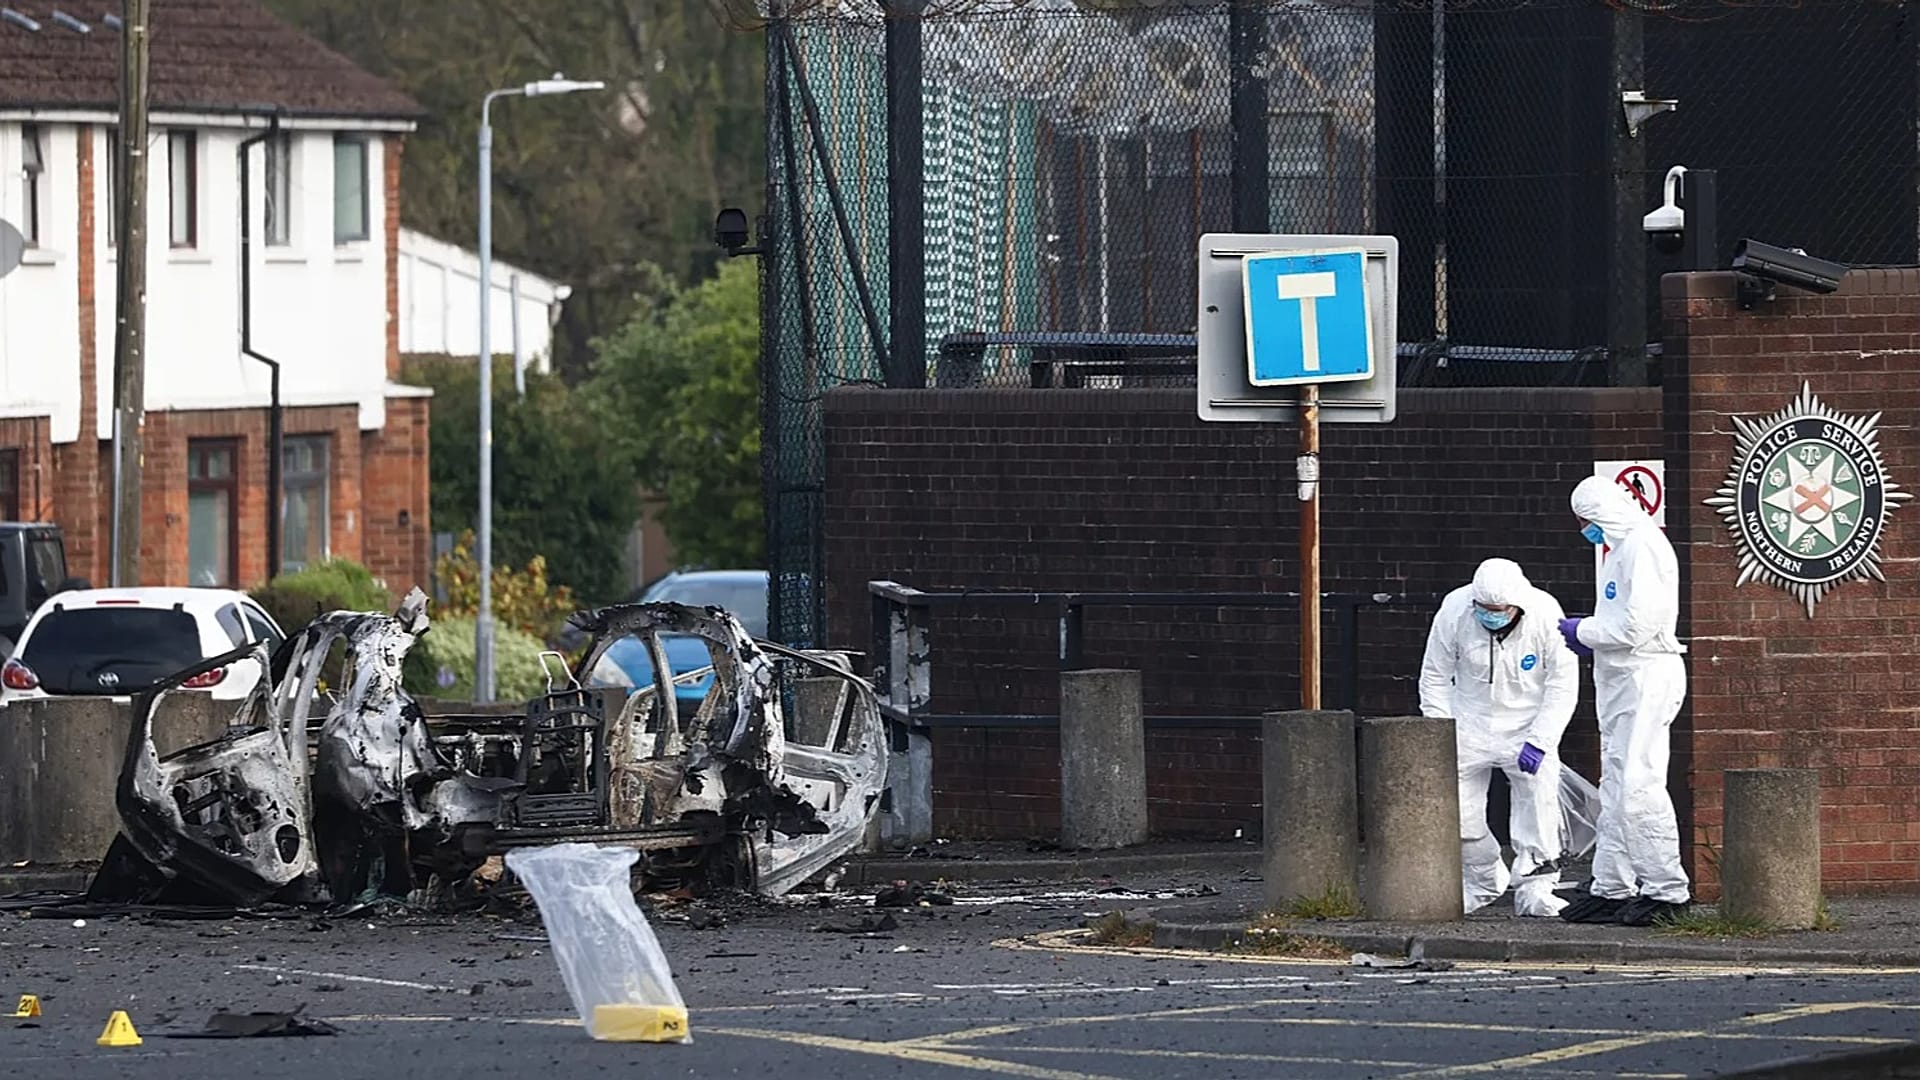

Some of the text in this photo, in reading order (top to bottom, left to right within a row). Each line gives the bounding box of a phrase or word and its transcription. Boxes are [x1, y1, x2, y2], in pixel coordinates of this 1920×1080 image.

[1745, 424, 1878, 487] POLICE SERVICE
[1746, 510, 1875, 573] NORTHERN IRELAND
